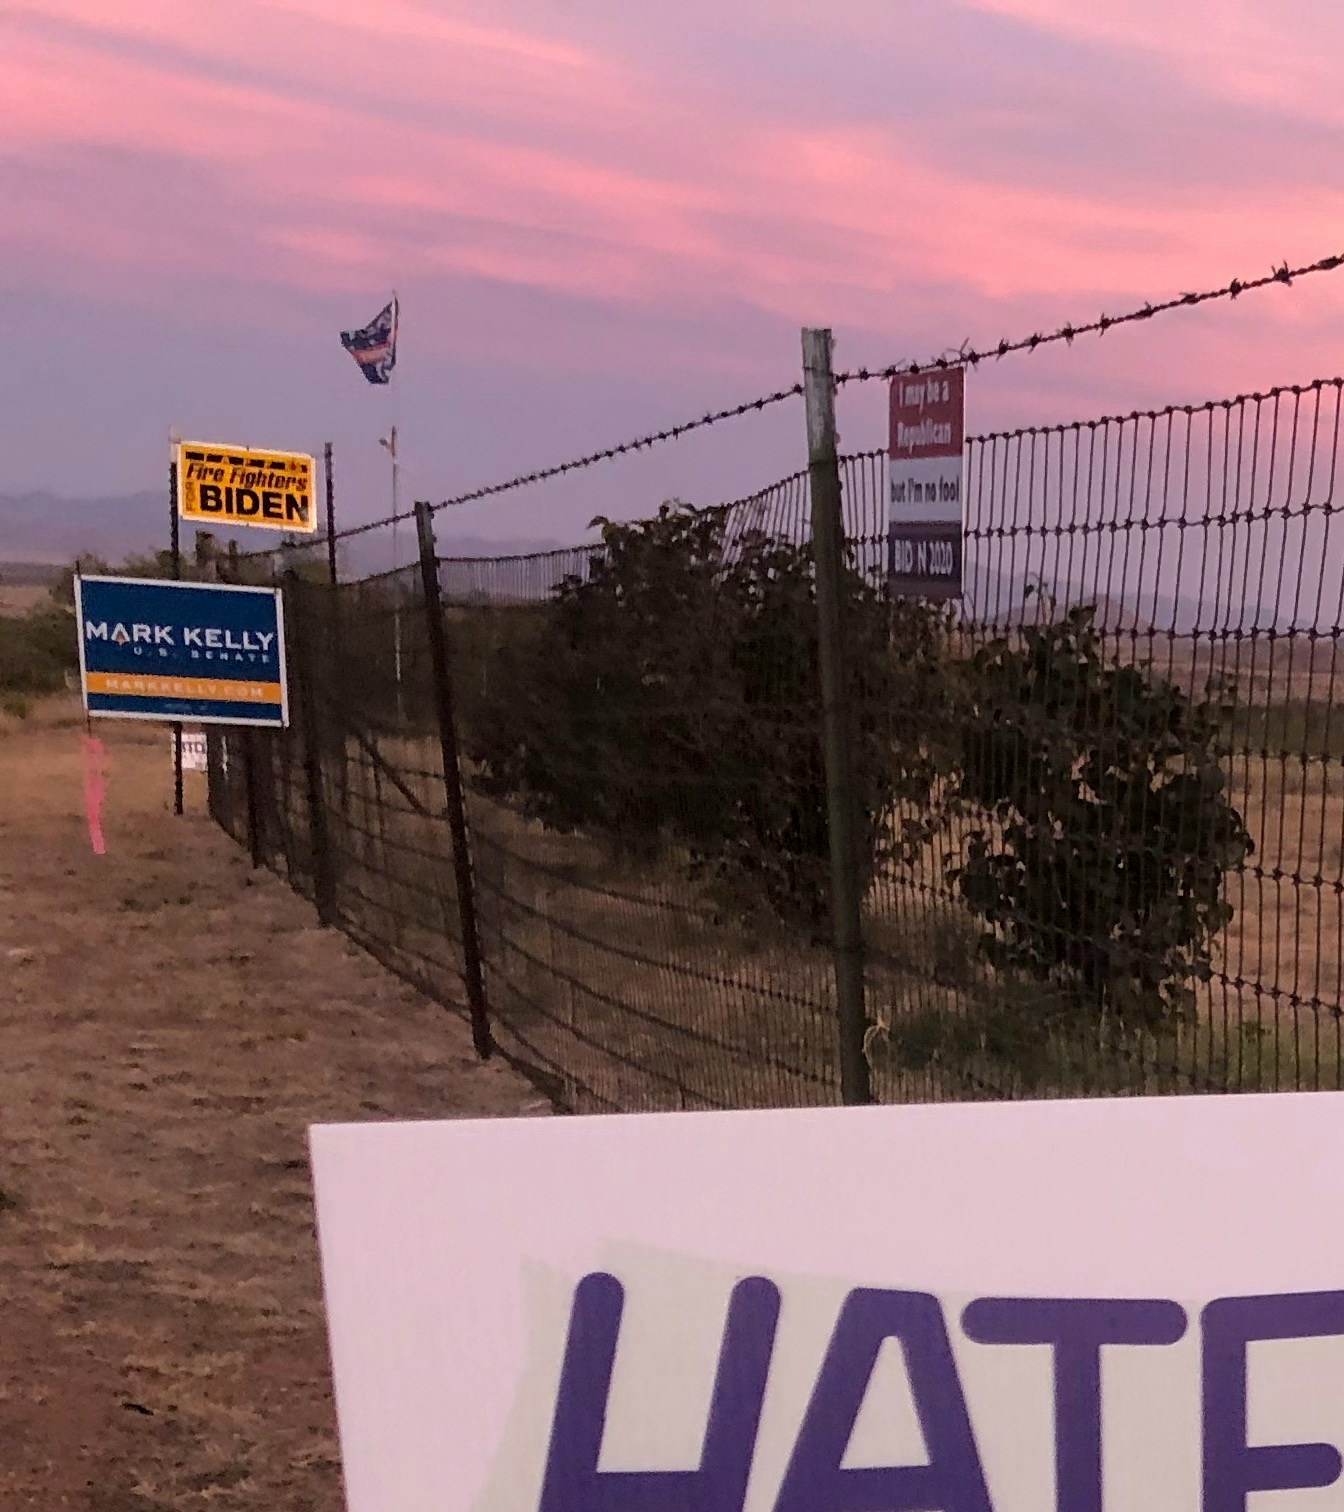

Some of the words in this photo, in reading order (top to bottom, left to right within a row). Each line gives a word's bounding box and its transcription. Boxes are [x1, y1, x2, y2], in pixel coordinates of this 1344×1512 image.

[899, 380, 904, 408] I
[905, 384, 926, 414] may
[927, 375, 940, 404] be
[942, 379, 950, 402] a
[897, 418, 951, 454] Republican
[186, 462, 226, 483] Fire
[229, 467, 309, 492] Fighters
[891, 478, 905, 503] but
[925, 481, 937, 503] no
[939, 474, 960, 503] fool
[199, 484, 309, 523] BIDEN
[929, 540, 953, 575] 2020
[85, 620, 175, 646] MARK
[183, 626, 274, 651] KELLY
[190, 649, 270, 663] SENATE
[105, 678, 264, 698] MARKKELLY.COM
